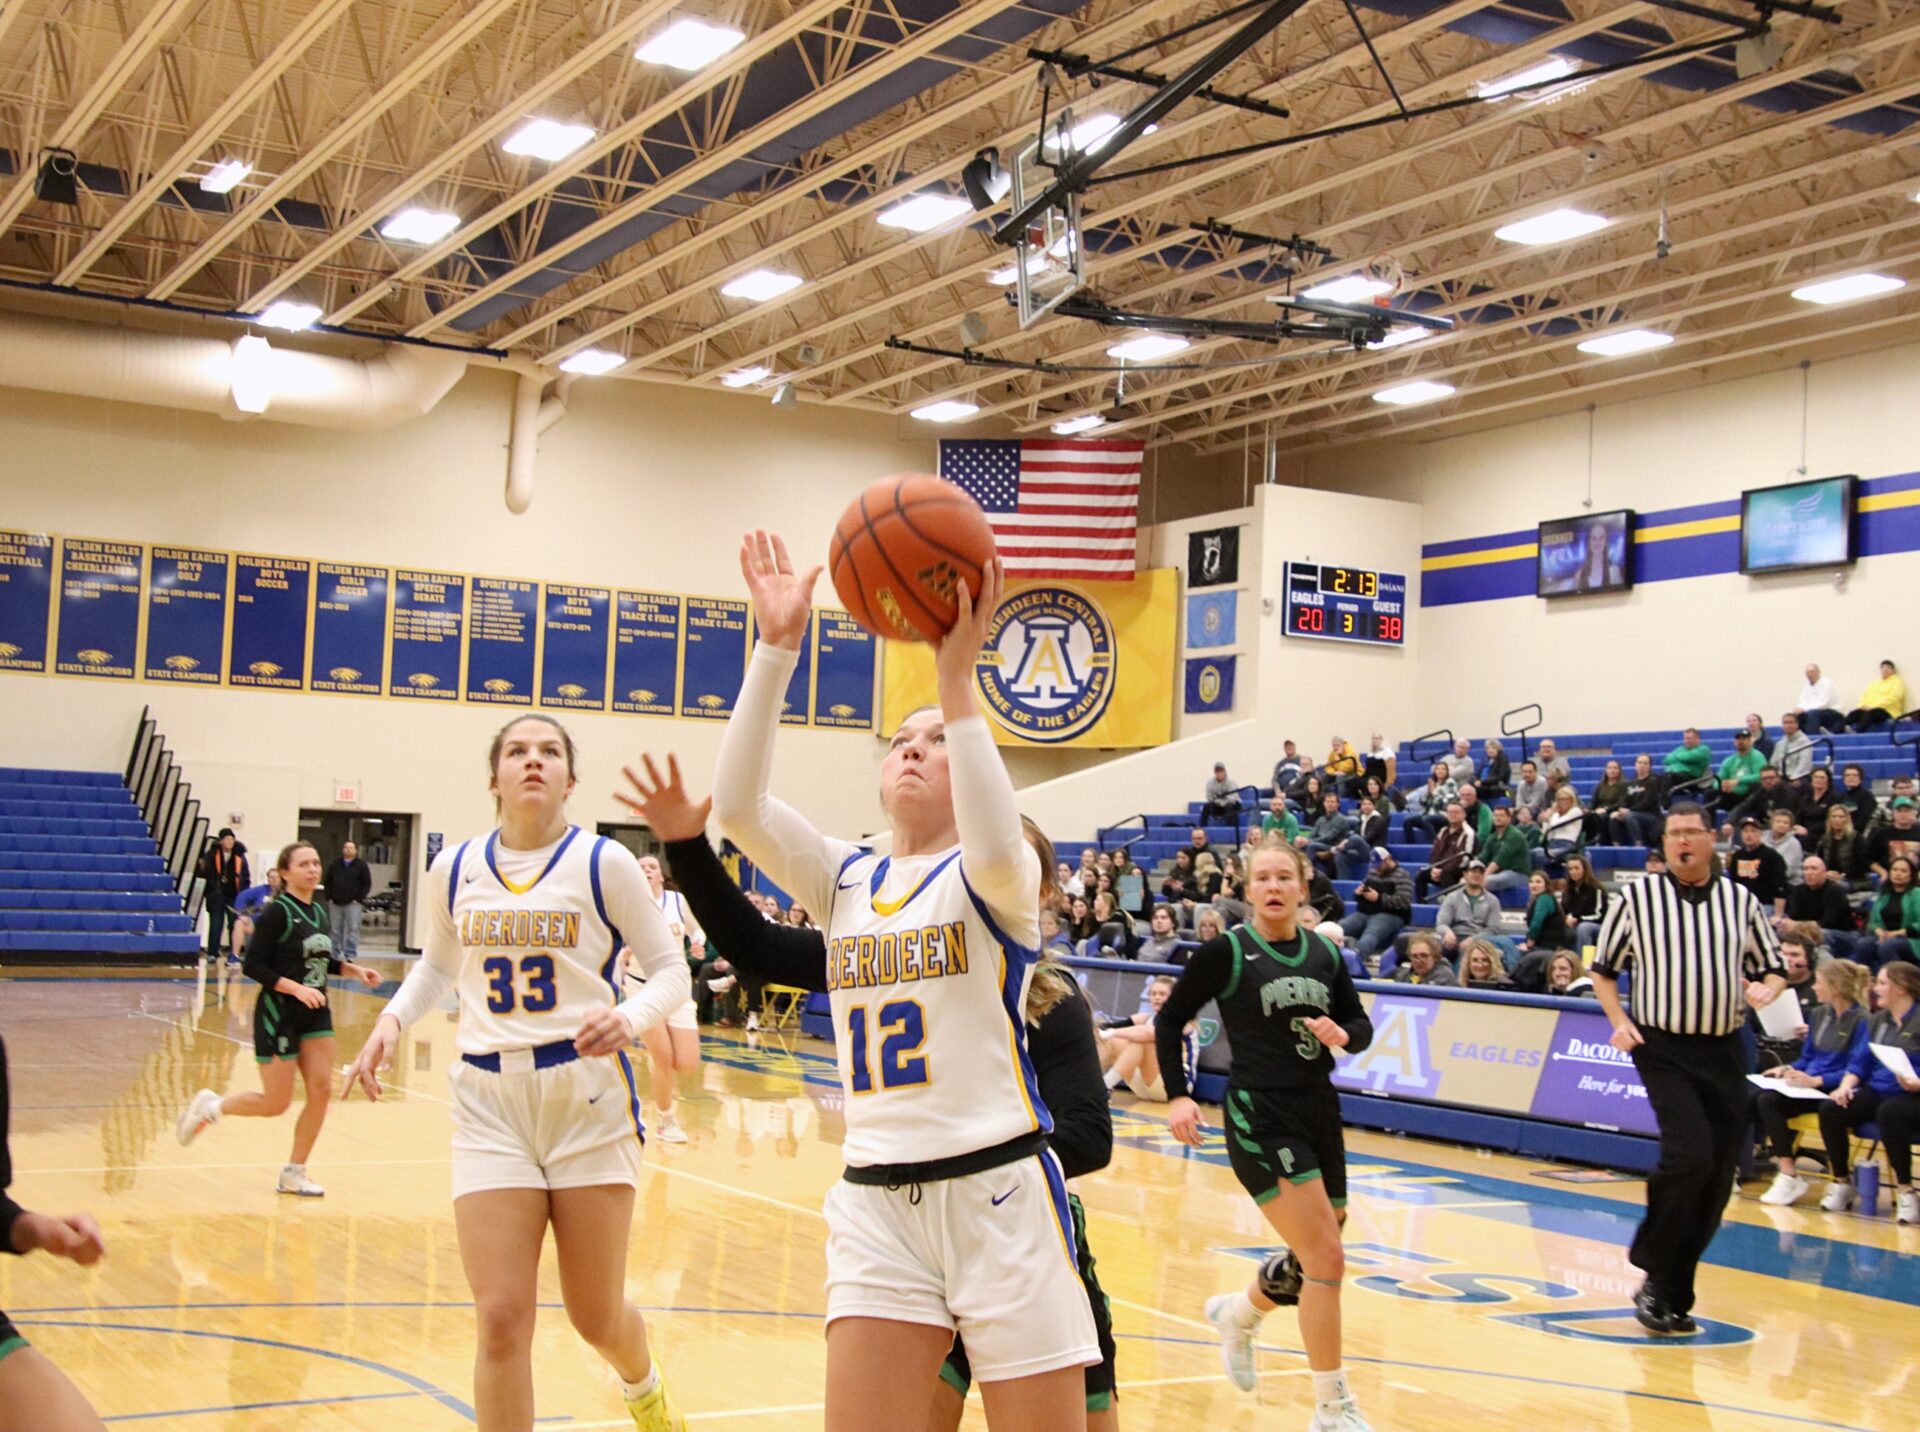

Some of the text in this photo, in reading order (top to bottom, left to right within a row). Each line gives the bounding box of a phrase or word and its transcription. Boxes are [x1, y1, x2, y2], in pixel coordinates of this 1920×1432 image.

[66, 541, 140, 556] GOLDEN EAGLES
[71, 553, 133, 566] BASKETBALL
[154, 549, 226, 564] GOLDEN EAGLES
[238, 556, 308, 571] GOLDEN EAGLES
[65, 562, 138, 576] CHEERLEADERS
[177, 562, 202, 572] BOYS
[260, 569, 285, 579] BOYS
[319, 564, 386, 578] GOLDEN EAGLES
[178, 571, 201, 582] GOLF
[255, 578, 289, 590] SOCCER
[398, 572, 463, 585] GOLDEN EAGLES
[1334, 569, 1377, 596] 2:13
[548, 585, 609, 599] GOLDEN EAGLES
[619, 592, 678, 606] GOLDEN EAGLES
[689, 599, 745, 612] GOLDEN EAGLES
[1291, 591, 1401, 614] EAGLES GUEST
[1336, 602, 1359, 612] PERIOD
[620, 611, 647, 622] TRACK
[654, 614, 676, 624] FIELD
[690, 617, 715, 628] TRACK
[722, 620, 743, 630] FIELD
[986, 592, 1053, 647] ABERDEEN
[1057, 593, 1104, 647] CENTRAL
[1298, 607, 1402, 640] 20 3 38
[981, 671, 1104, 728] HOME OF THE EAGLES
[827, 920, 969, 992] BERDEEN
[482, 951, 558, 1016] 33
[848, 996, 932, 1096] 12
[1289, 1016, 1322, 1061] 3
[1449, 1041, 1543, 1069] EAGLES
[1566, 1038, 1634, 1064] DACOTA
[1577, 1074, 1607, 1093] Here
[1602, 1078, 1627, 1097] for
[1276, 1146, 1296, 1174] P
